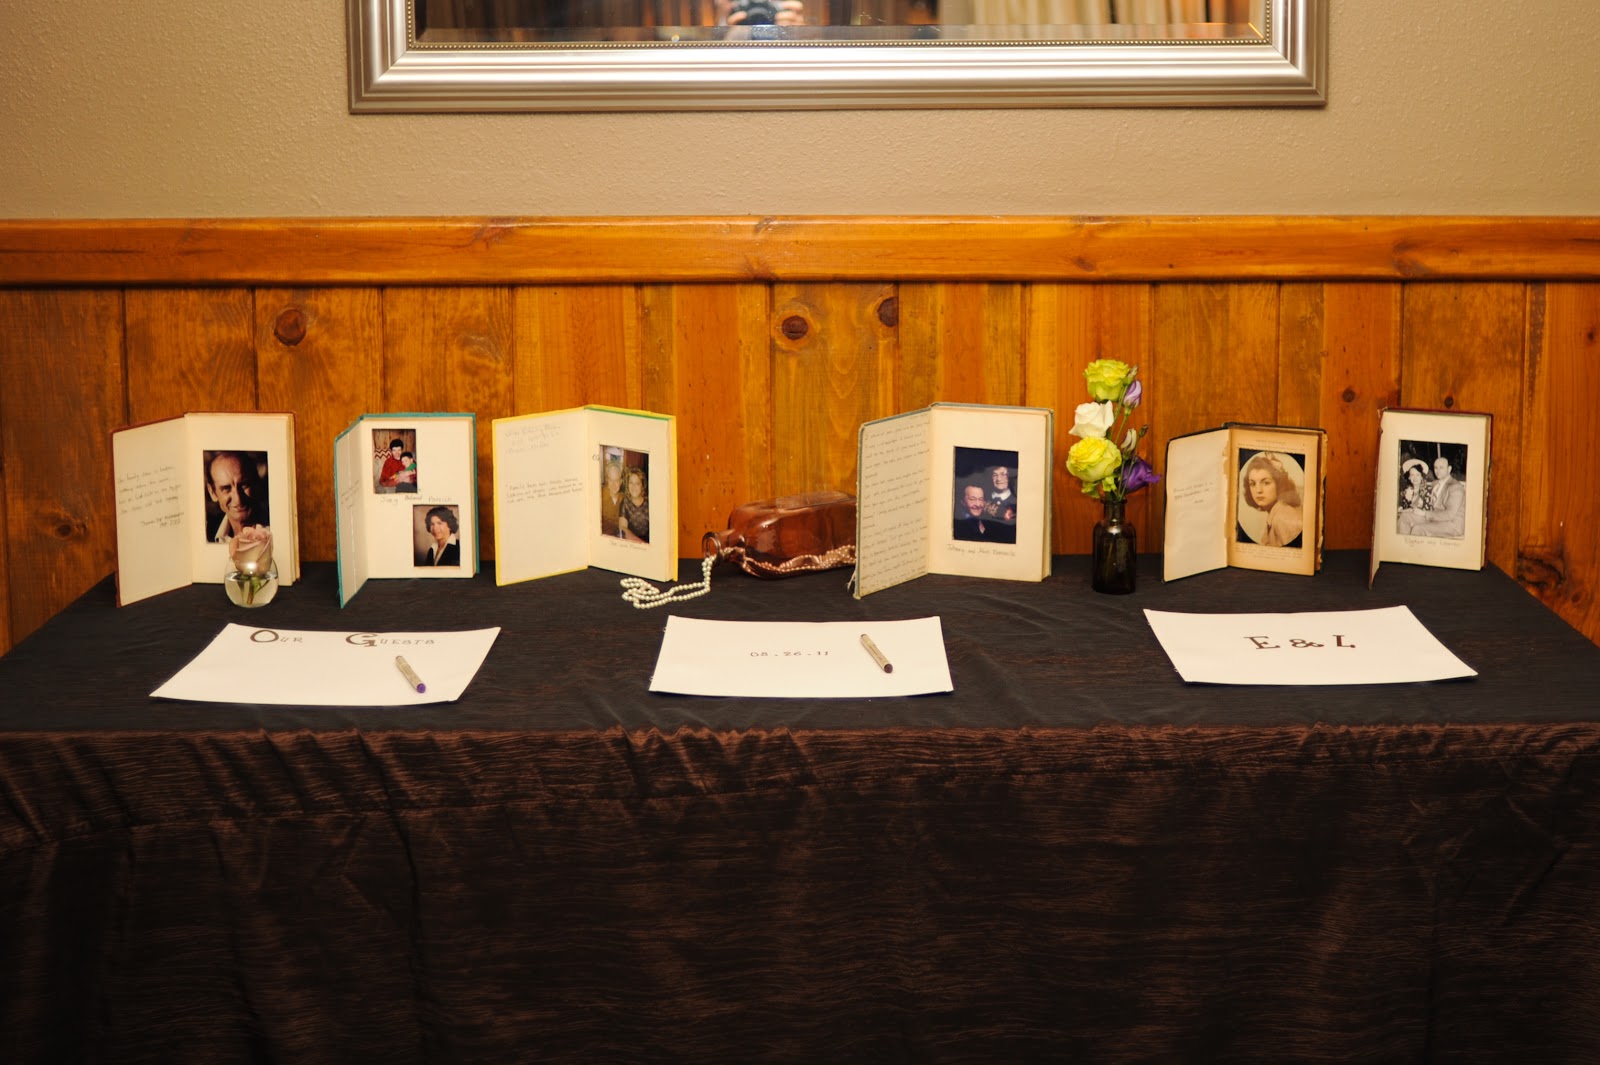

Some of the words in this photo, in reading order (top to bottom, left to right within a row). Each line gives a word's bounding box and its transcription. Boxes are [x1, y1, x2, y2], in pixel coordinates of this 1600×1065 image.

[1243, 635, 1281, 650] E
[1288, 638, 1325, 649] &
[1332, 634, 1356, 649] L
